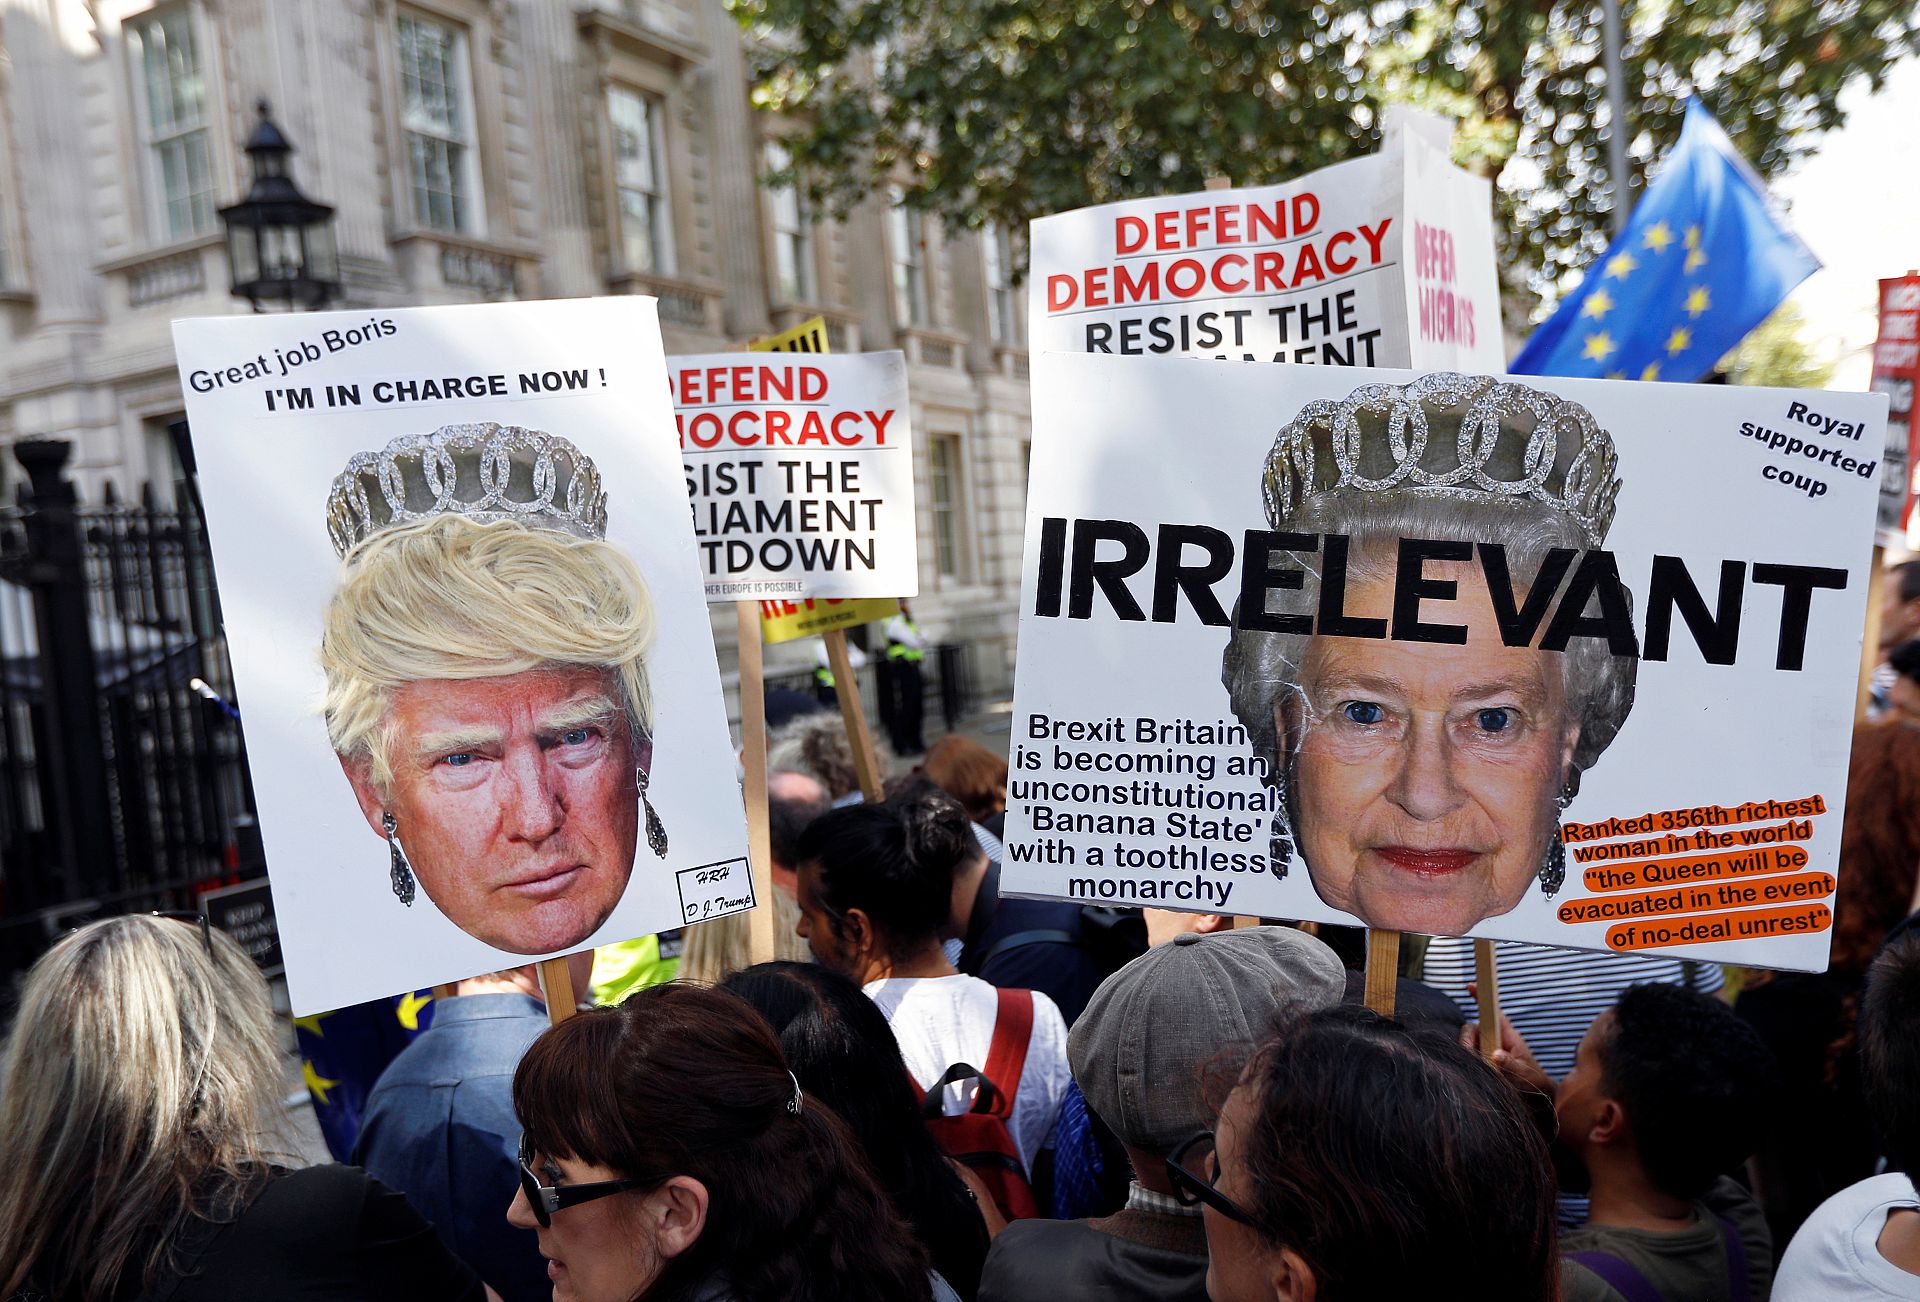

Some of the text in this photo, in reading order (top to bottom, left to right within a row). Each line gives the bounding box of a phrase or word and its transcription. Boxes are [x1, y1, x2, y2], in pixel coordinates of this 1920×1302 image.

[1115, 192, 1321, 255] DEFEND
[1047, 218, 1393, 313] DEMOCRACY
[1086, 289, 1358, 355] RESIST THE
[189, 317, 397, 393] Great job Boris
[265, 387, 315, 412] I'M
[326, 384, 362, 408] IN
[373, 375, 508, 404] CHARGE
[519, 369, 589, 394] NOW
[669, 366, 829, 405] EFEND
[675, 409, 895, 449] OCRACY
[1786, 401, 1866, 441] Royal
[1739, 420, 1877, 479] supported
[778, 460, 860, 494] THE
[1762, 464, 1828, 498] coup
[723, 583, 752, 595] EUROPE
[754, 582, 763, 593] IS
[764, 582, 803, 593] POSSIBLE
[1034, 517, 1849, 672] IRRELEVANT
[1028, 714, 1246, 746] Brexit Britain
[1016, 744, 1268, 780] is becoming an
[1011, 779, 1276, 812] unconstitutional
[1024, 805, 1262, 843] 'Banana State'
[1563, 796, 1825, 844] Ranked 356th richest
[1009, 838, 1266, 874] with a toothless
[1574, 821, 1812, 863] woman in the world
[695, 866, 730, 885] HRH
[1585, 849, 1807, 890] "the Queen will be
[686, 902, 698, 917] D
[714, 894, 752, 911] Trump
[1069, 875, 1234, 907] monarchy
[1558, 875, 1835, 921] evacuated in the event
[1612, 908, 1830, 948] of no-deal unrest"
